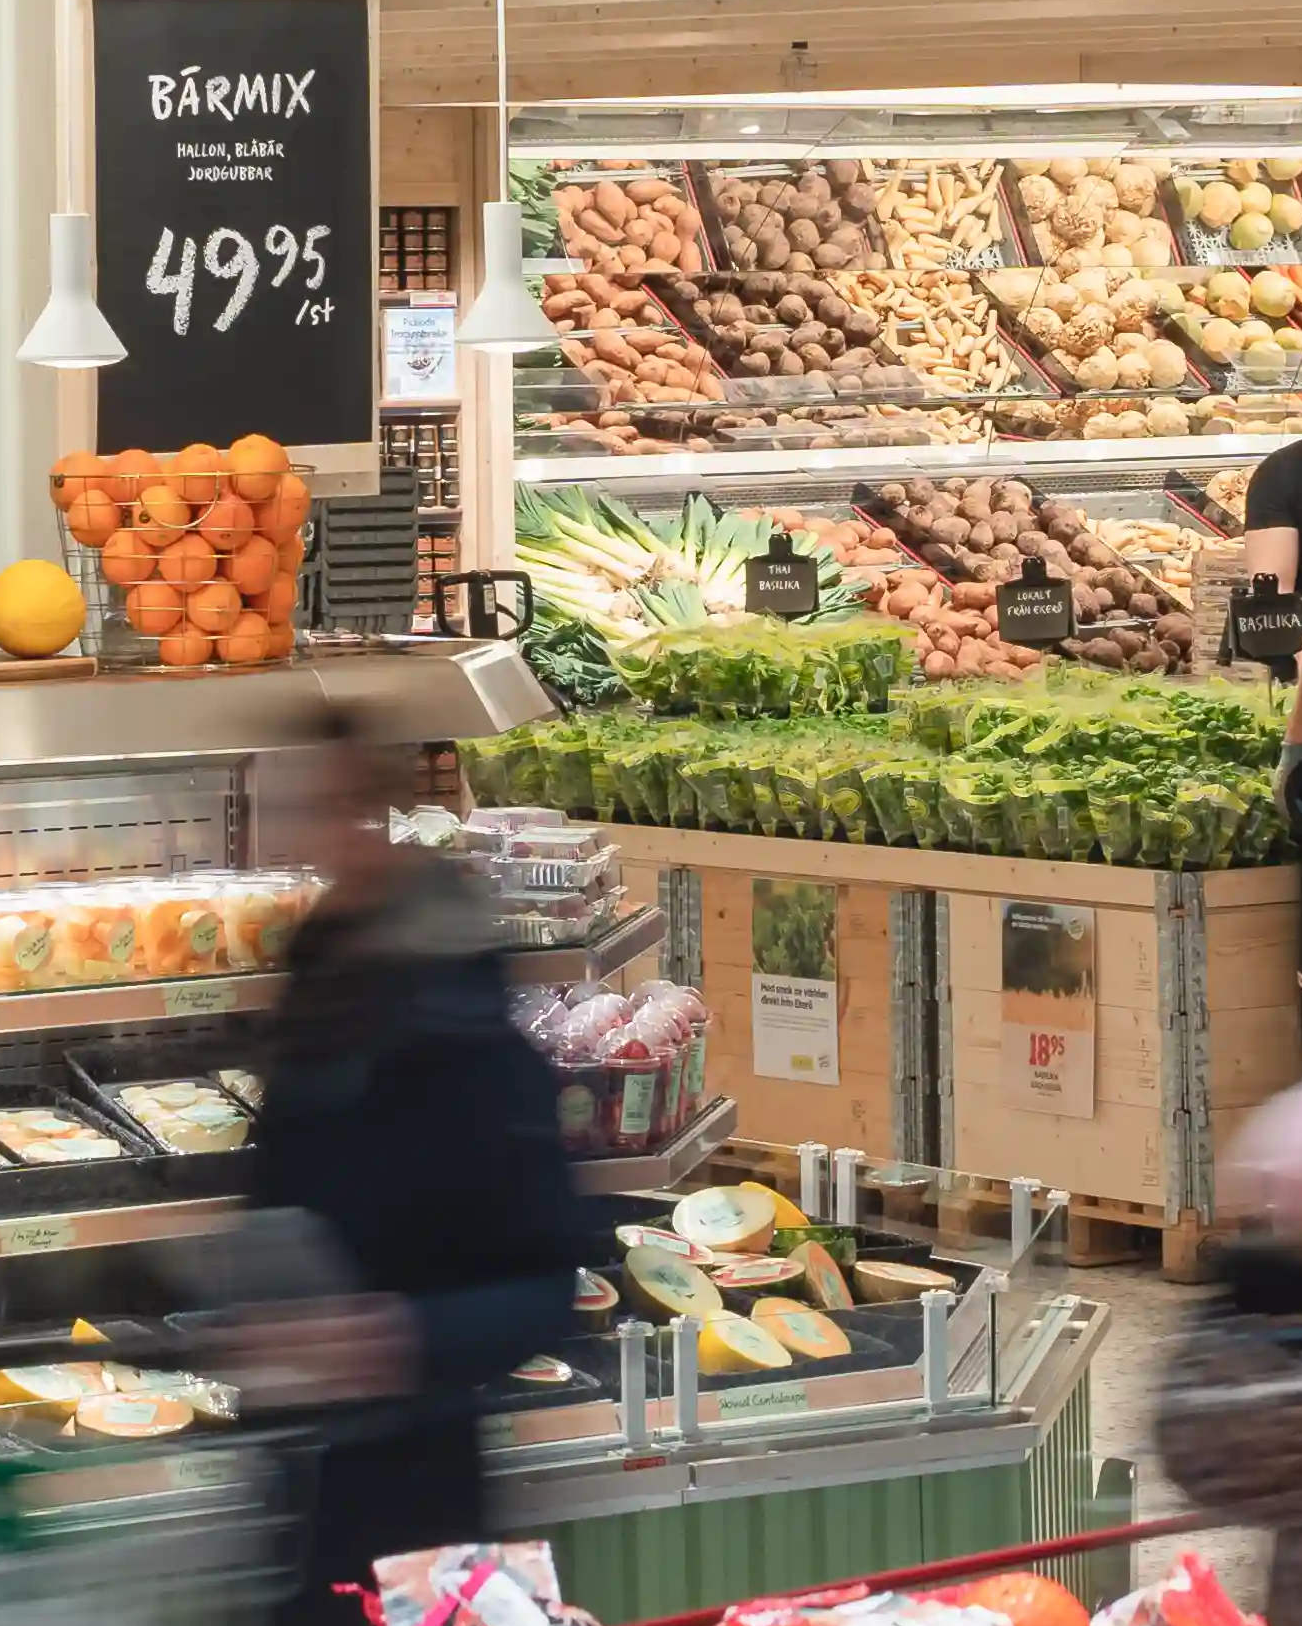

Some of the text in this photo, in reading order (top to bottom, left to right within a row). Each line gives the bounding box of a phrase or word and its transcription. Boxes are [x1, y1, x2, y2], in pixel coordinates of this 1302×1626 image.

[148, 65, 316, 122] BÄRMIX
[177, 139, 285, 161] HALLON, BLÅBÄR
[187, 164, 273, 182] JORDGUBBAR
[295, 297, 336, 326] /st
[768, 564, 791, 575] THAI
[759, 579, 801, 592] BASILIKA
[1017, 589, 1052, 601] LOKALT
[1238, 613, 1302, 632] BASILIKA
